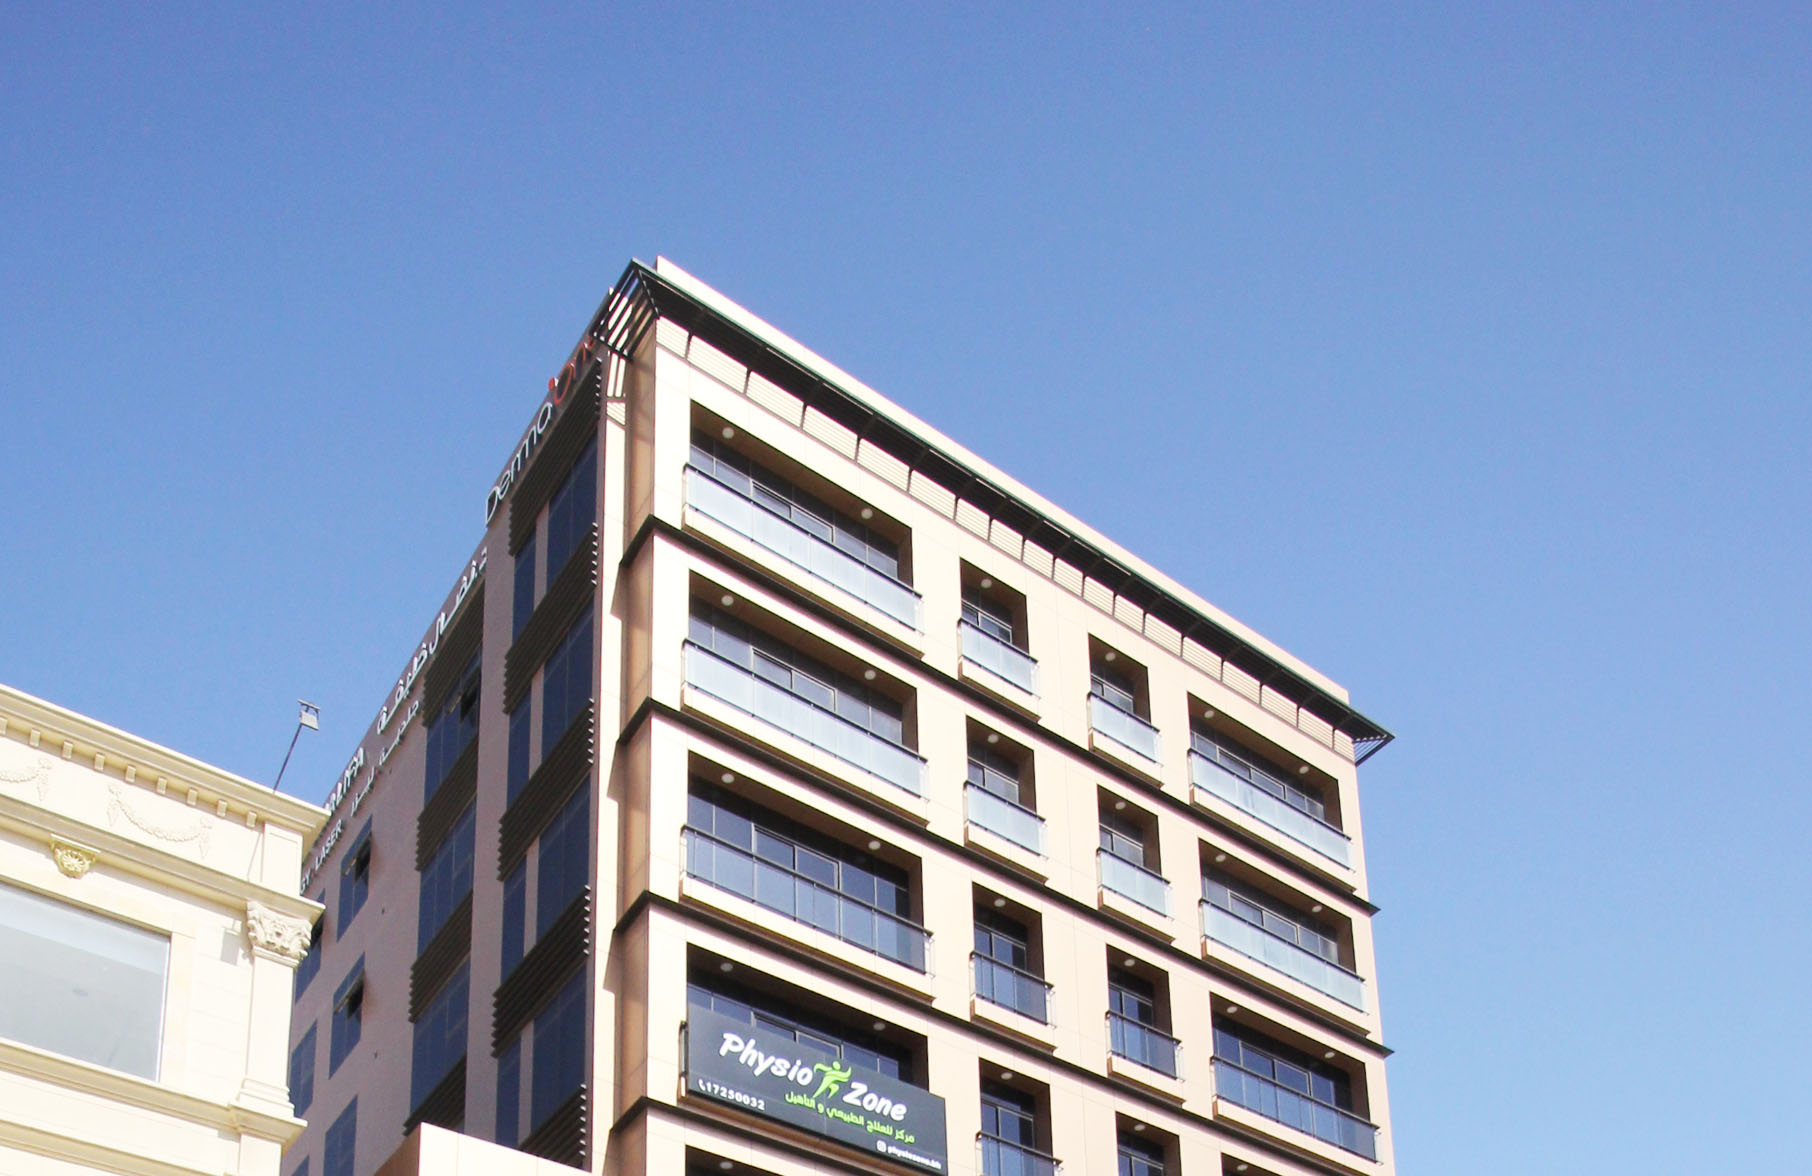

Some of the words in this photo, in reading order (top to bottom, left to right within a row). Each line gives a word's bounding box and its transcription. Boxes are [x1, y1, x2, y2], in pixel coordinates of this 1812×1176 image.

[486, 402, 553, 527] Derma
[323, 747, 364, 812] ALIFA
[315, 819, 343, 870] LASER
[706, 1081, 765, 1111] 17250032
[719, 1032, 813, 1086] Physio
[842, 1081, 907, 1121] Zone
[826, 1107, 864, 1125] الطبيعي
[866, 1120, 893, 1135] للعلاج
[894, 1129, 915, 1144] مركز
